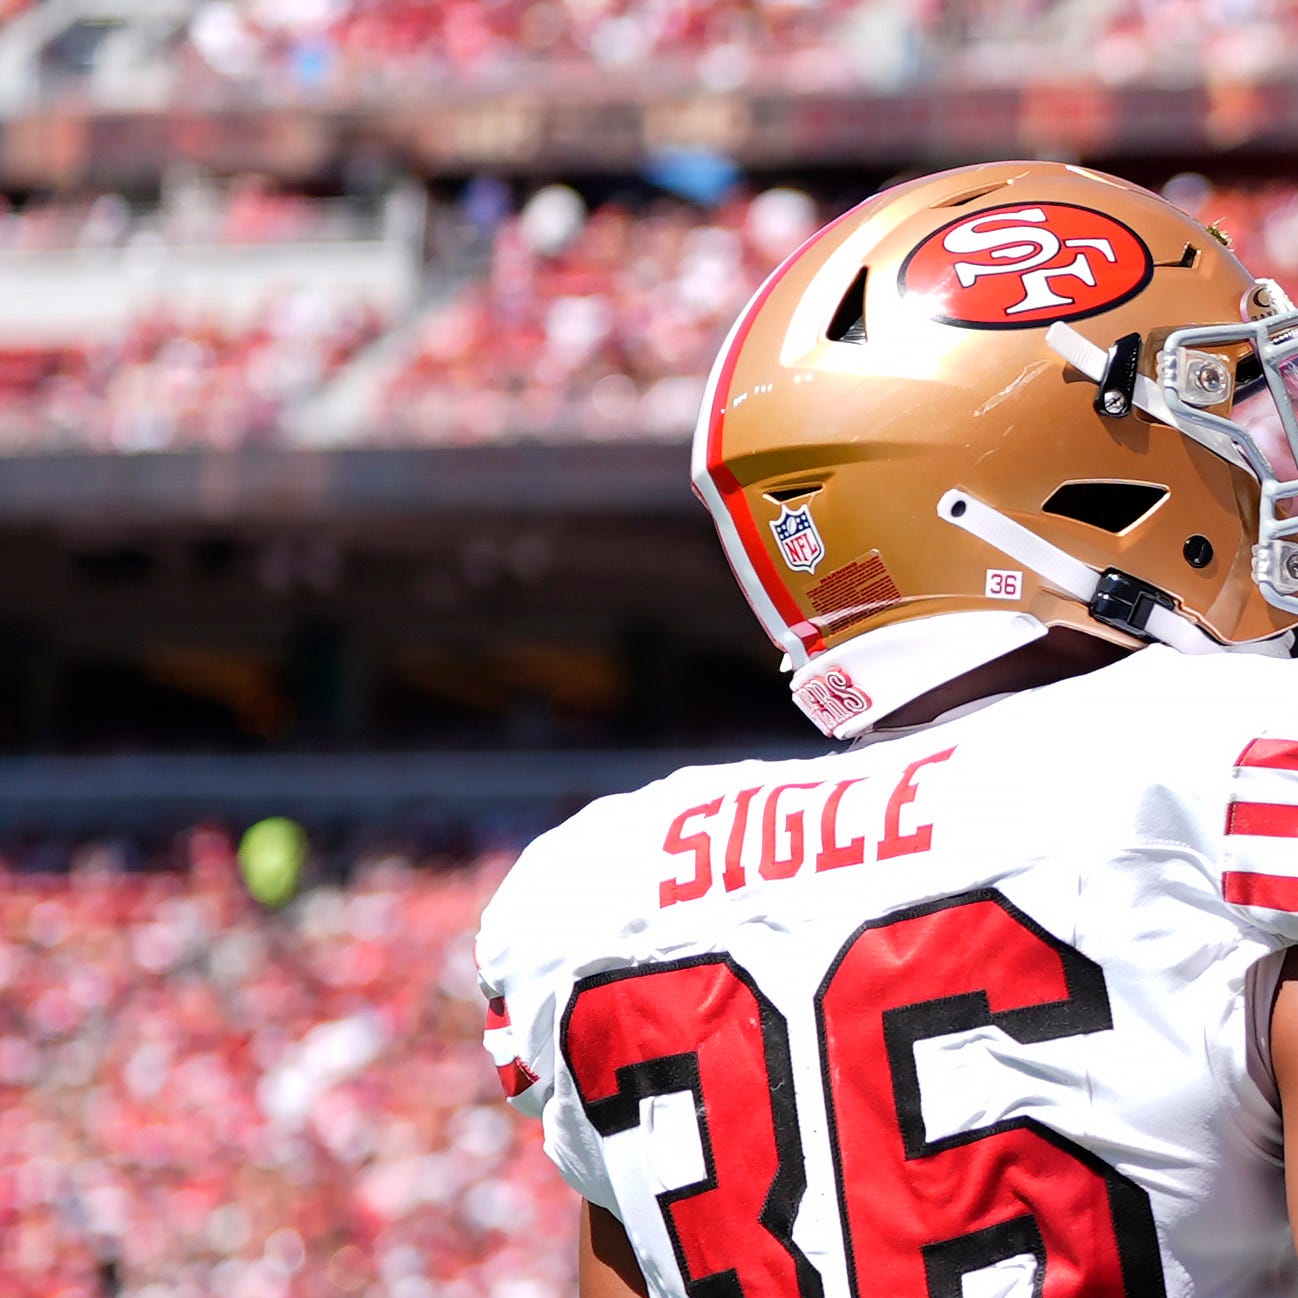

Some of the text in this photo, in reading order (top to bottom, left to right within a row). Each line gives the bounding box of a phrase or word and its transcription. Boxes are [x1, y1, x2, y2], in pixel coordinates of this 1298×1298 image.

[941, 207, 1118, 316] SF
[785, 533, 818, 562] NFL
[990, 573, 1017, 595] 36
[659, 745, 959, 909] SIGLE
